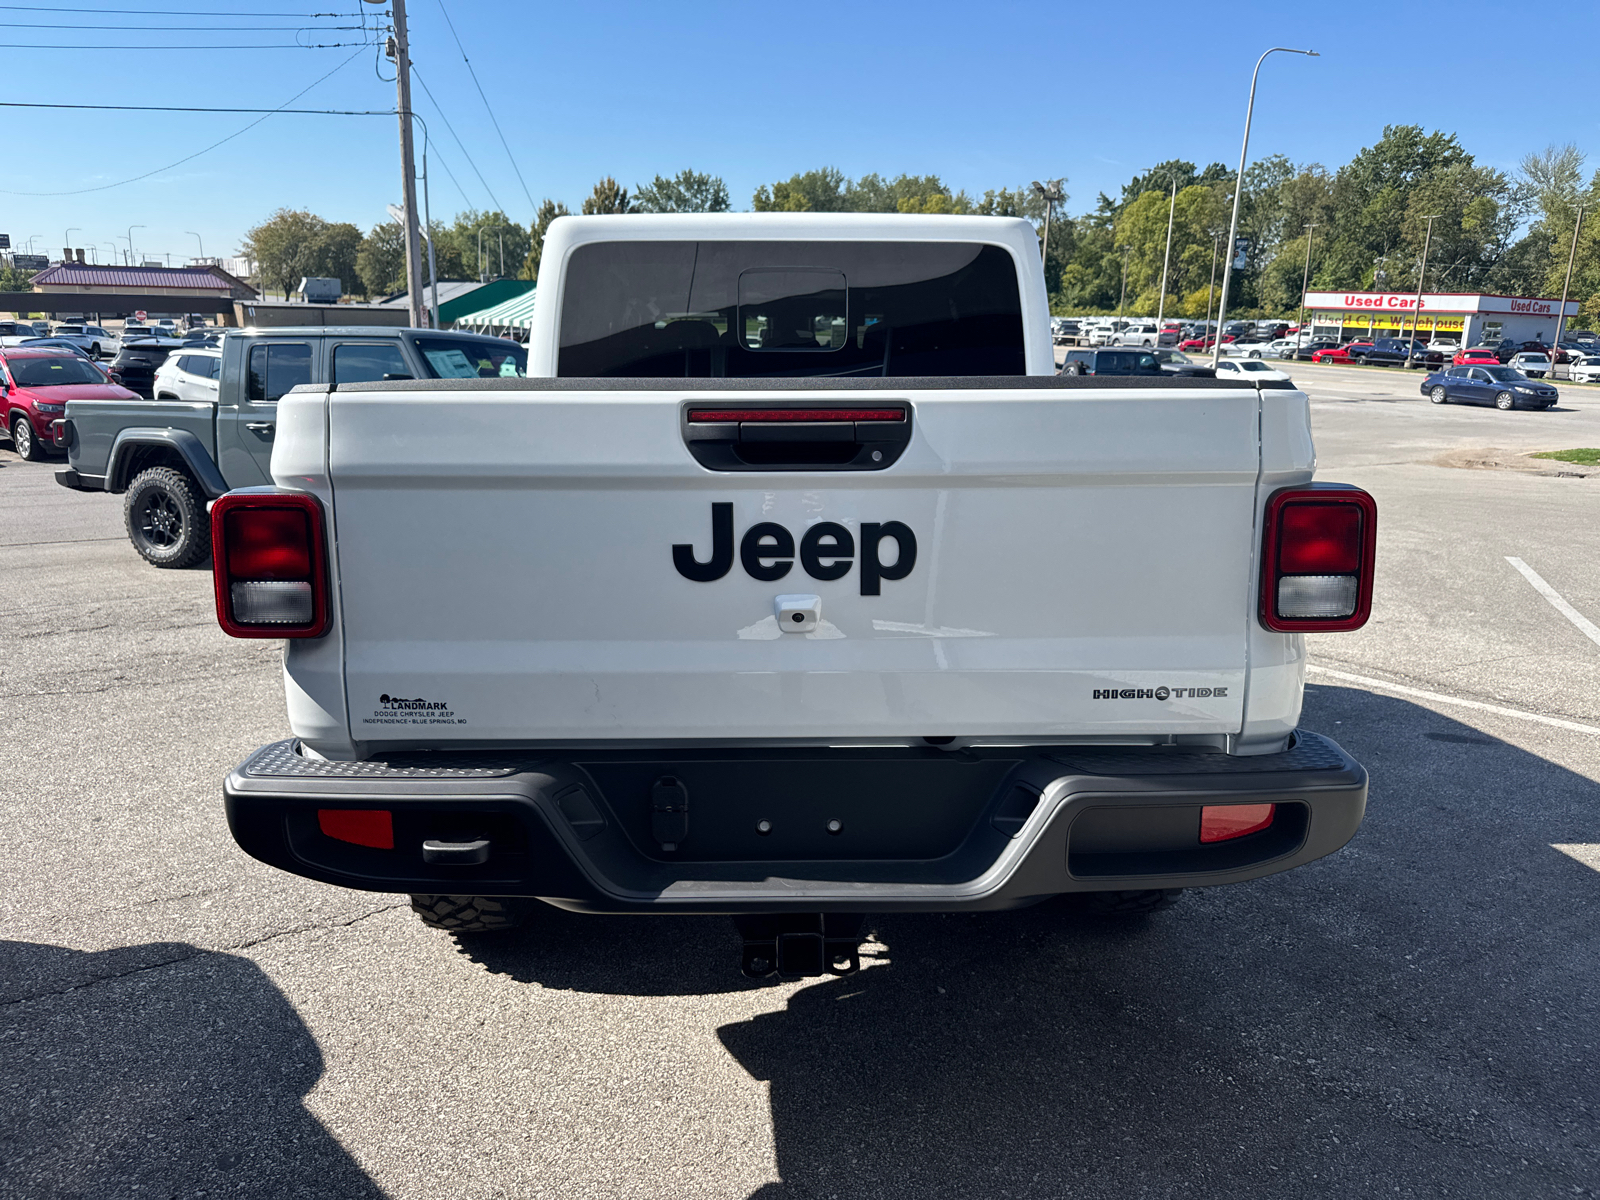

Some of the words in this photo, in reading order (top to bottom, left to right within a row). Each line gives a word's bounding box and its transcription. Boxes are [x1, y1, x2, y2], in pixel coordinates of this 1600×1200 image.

[1344, 295, 1383, 307] Used
[1387, 296, 1425, 308] Cars
[1510, 299, 1532, 312] Used
[1532, 301, 1551, 313] Cars
[1390, 315, 1465, 330] Waehouse
[672, 501, 917, 596] Jeep
[1092, 688, 1154, 699] HIGH
[1171, 687, 1228, 698] TIDE
[391, 702, 448, 710] LANDMARK
